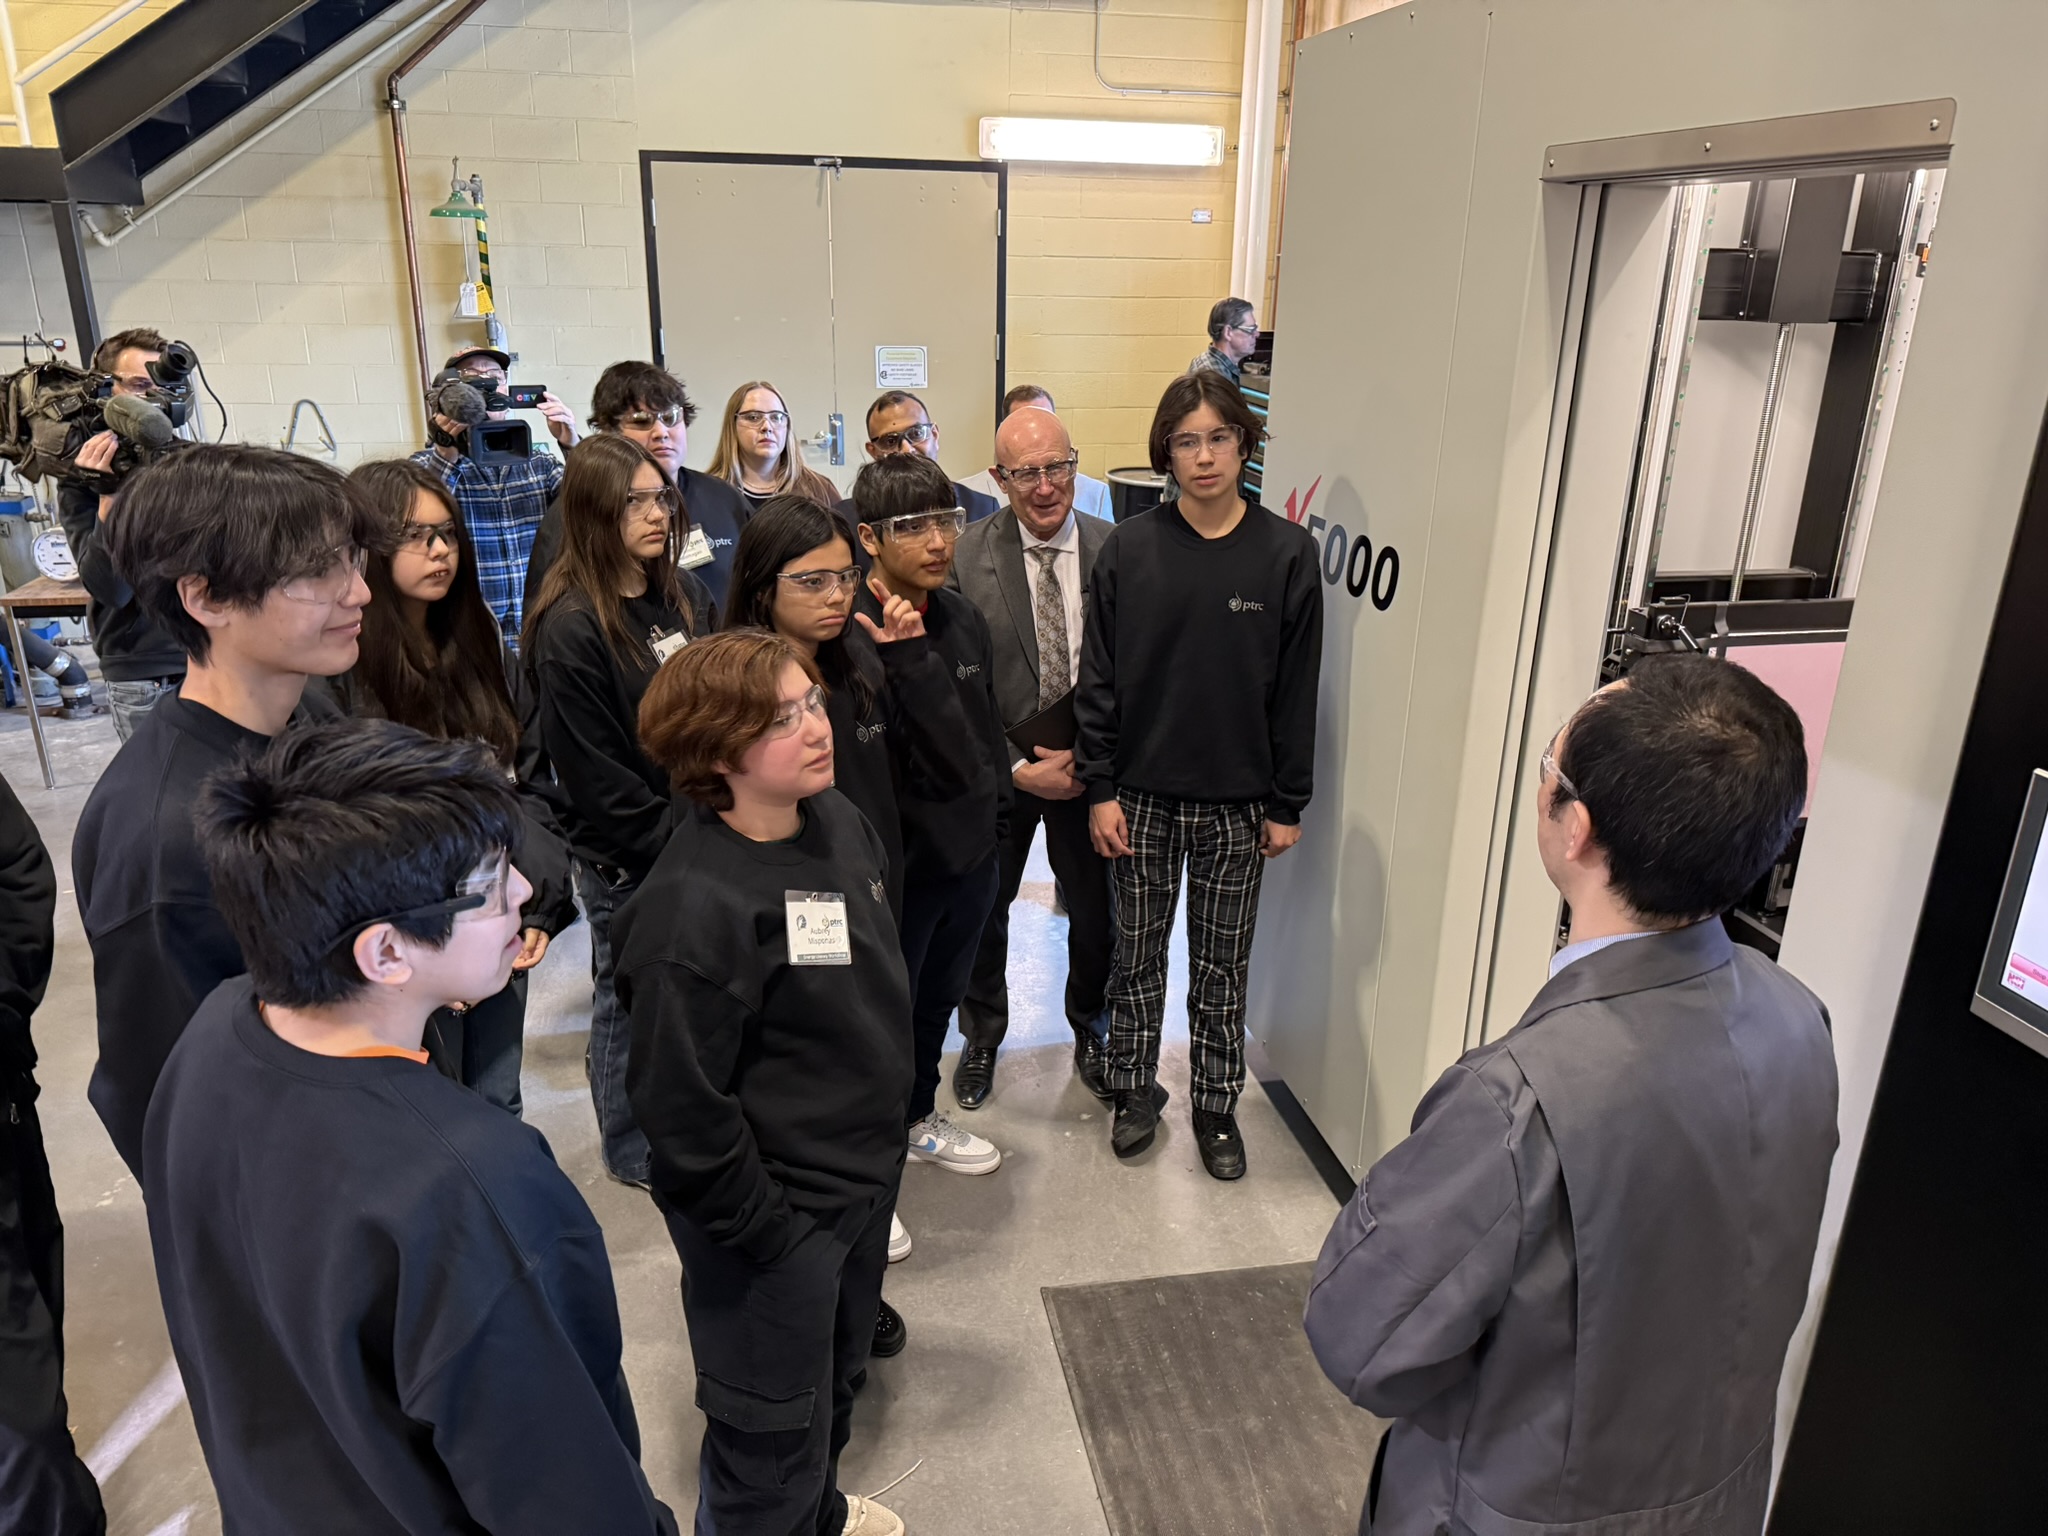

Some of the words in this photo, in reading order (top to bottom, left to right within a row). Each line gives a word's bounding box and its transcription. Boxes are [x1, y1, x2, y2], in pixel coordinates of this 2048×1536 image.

[516, 394, 538, 402] CTV
[714, 537, 733, 548] ptrc
[1242, 601, 1264, 612] ptrc
[829, 919, 843, 928] ptrc
